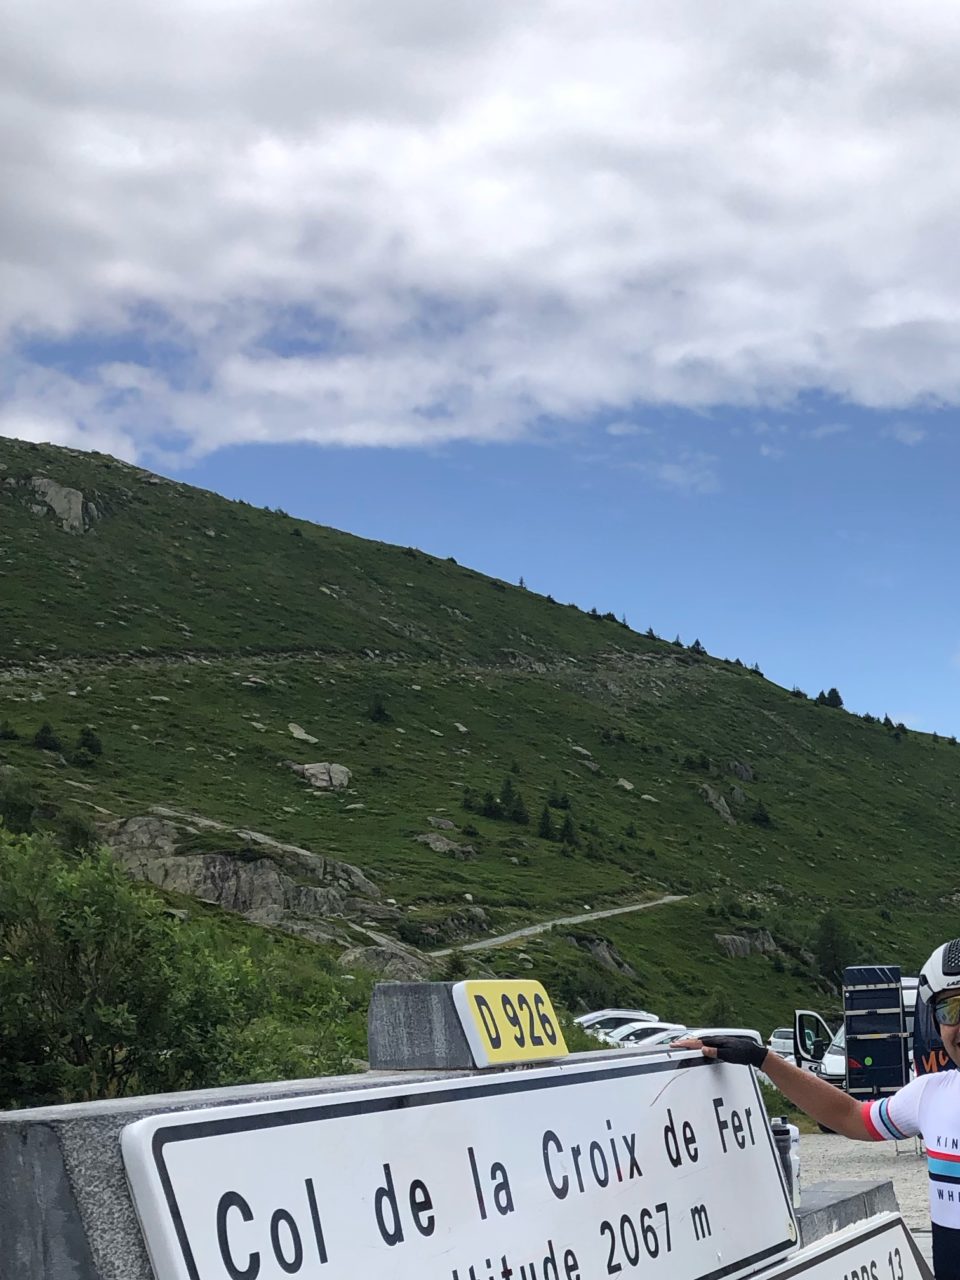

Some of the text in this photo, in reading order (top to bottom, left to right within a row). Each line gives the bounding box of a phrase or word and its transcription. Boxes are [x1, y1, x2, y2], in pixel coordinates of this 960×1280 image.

[474, 993, 557, 1050] D 926
[375, 1163, 435, 1246] de
[468, 1147, 515, 1220] la
[543, 1119, 643, 1200] Croix
[664, 1108, 699, 1168] de
[713, 1097, 756, 1154] Fer
[600, 1203, 672, 1276] 2067
[691, 1203, 712, 1241] m
